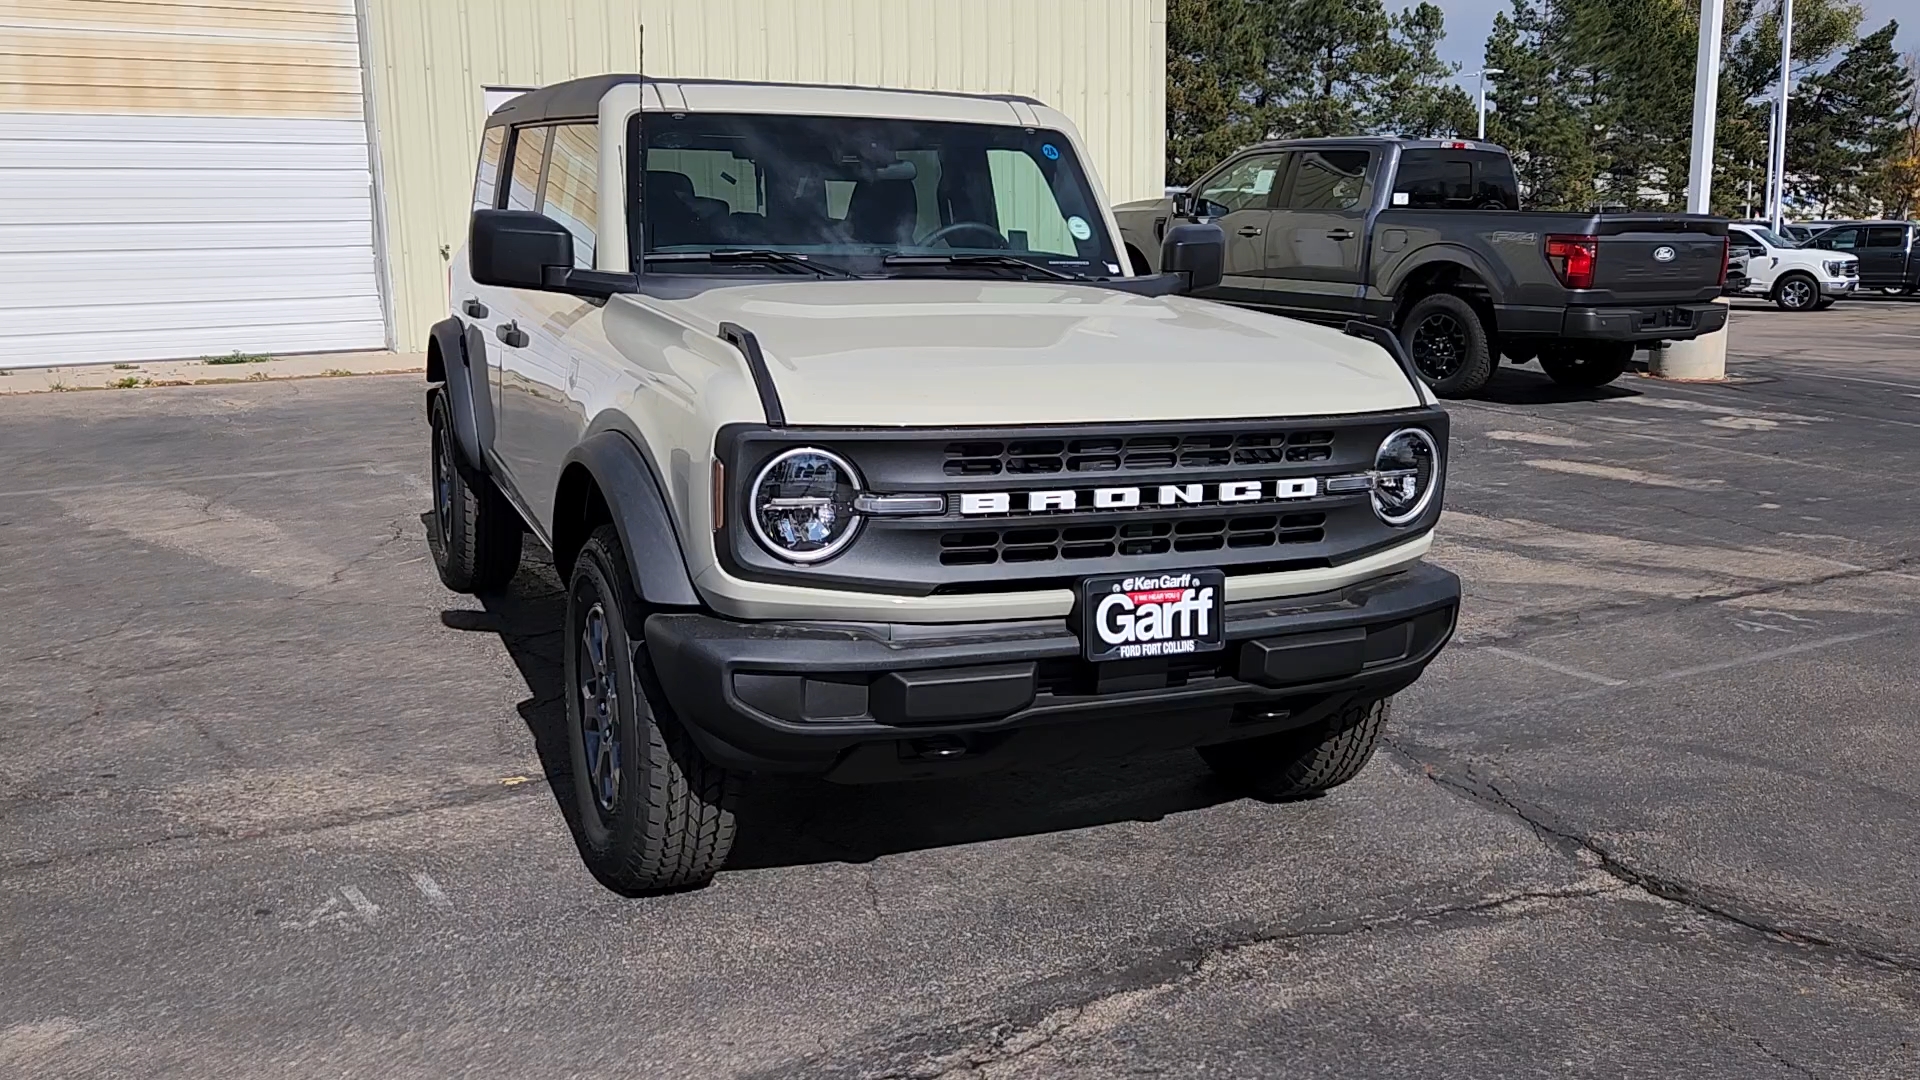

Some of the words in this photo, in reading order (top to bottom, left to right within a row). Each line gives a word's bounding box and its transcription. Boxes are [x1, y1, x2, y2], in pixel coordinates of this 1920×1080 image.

[960, 477, 1318, 514] BRONCO
[1134, 576, 1159, 590] Ken
[1160, 573, 1191, 588] Garff
[1096, 587, 1213, 644] Garff
[1120, 645, 1141, 658] FORD
[1142, 642, 1162, 656] FORT
[1163, 640, 1195, 654] COLLINS
